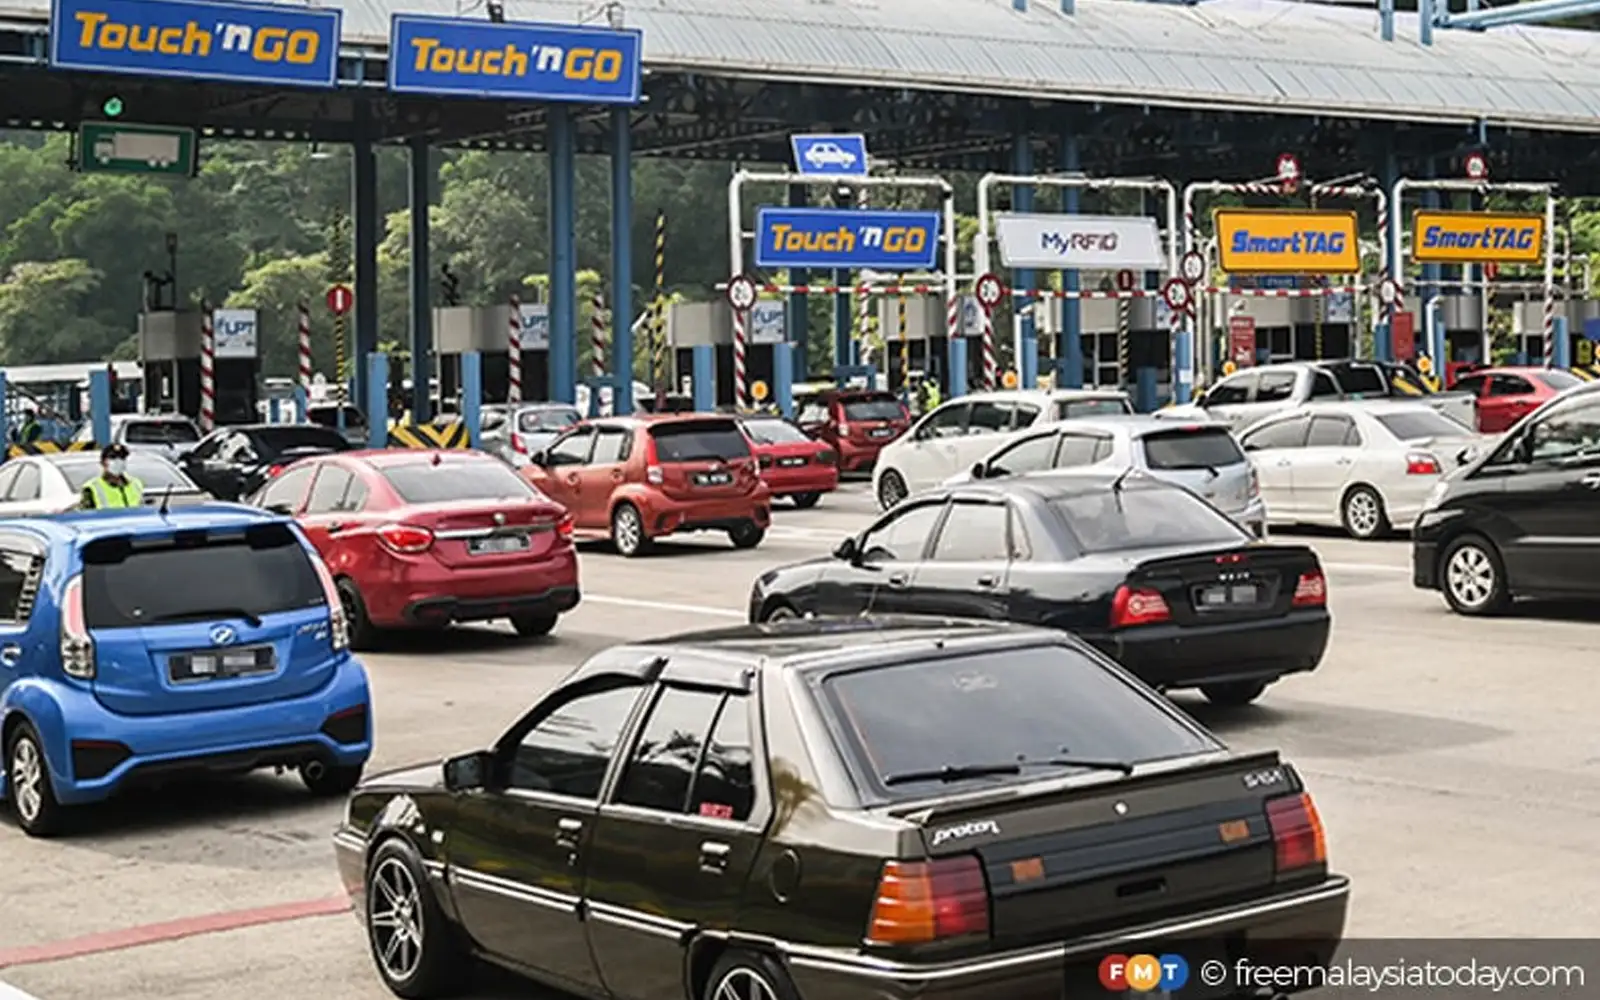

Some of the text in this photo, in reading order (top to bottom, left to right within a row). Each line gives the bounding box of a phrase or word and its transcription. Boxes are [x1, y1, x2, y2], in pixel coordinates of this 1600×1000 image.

[76, 12, 211, 56] Touch
[412, 38, 527, 75] Touch
[772, 224, 855, 252] Touch
[1231, 229, 1346, 254] SmartTAG
[1422, 225, 1536, 250] SmartTAG
